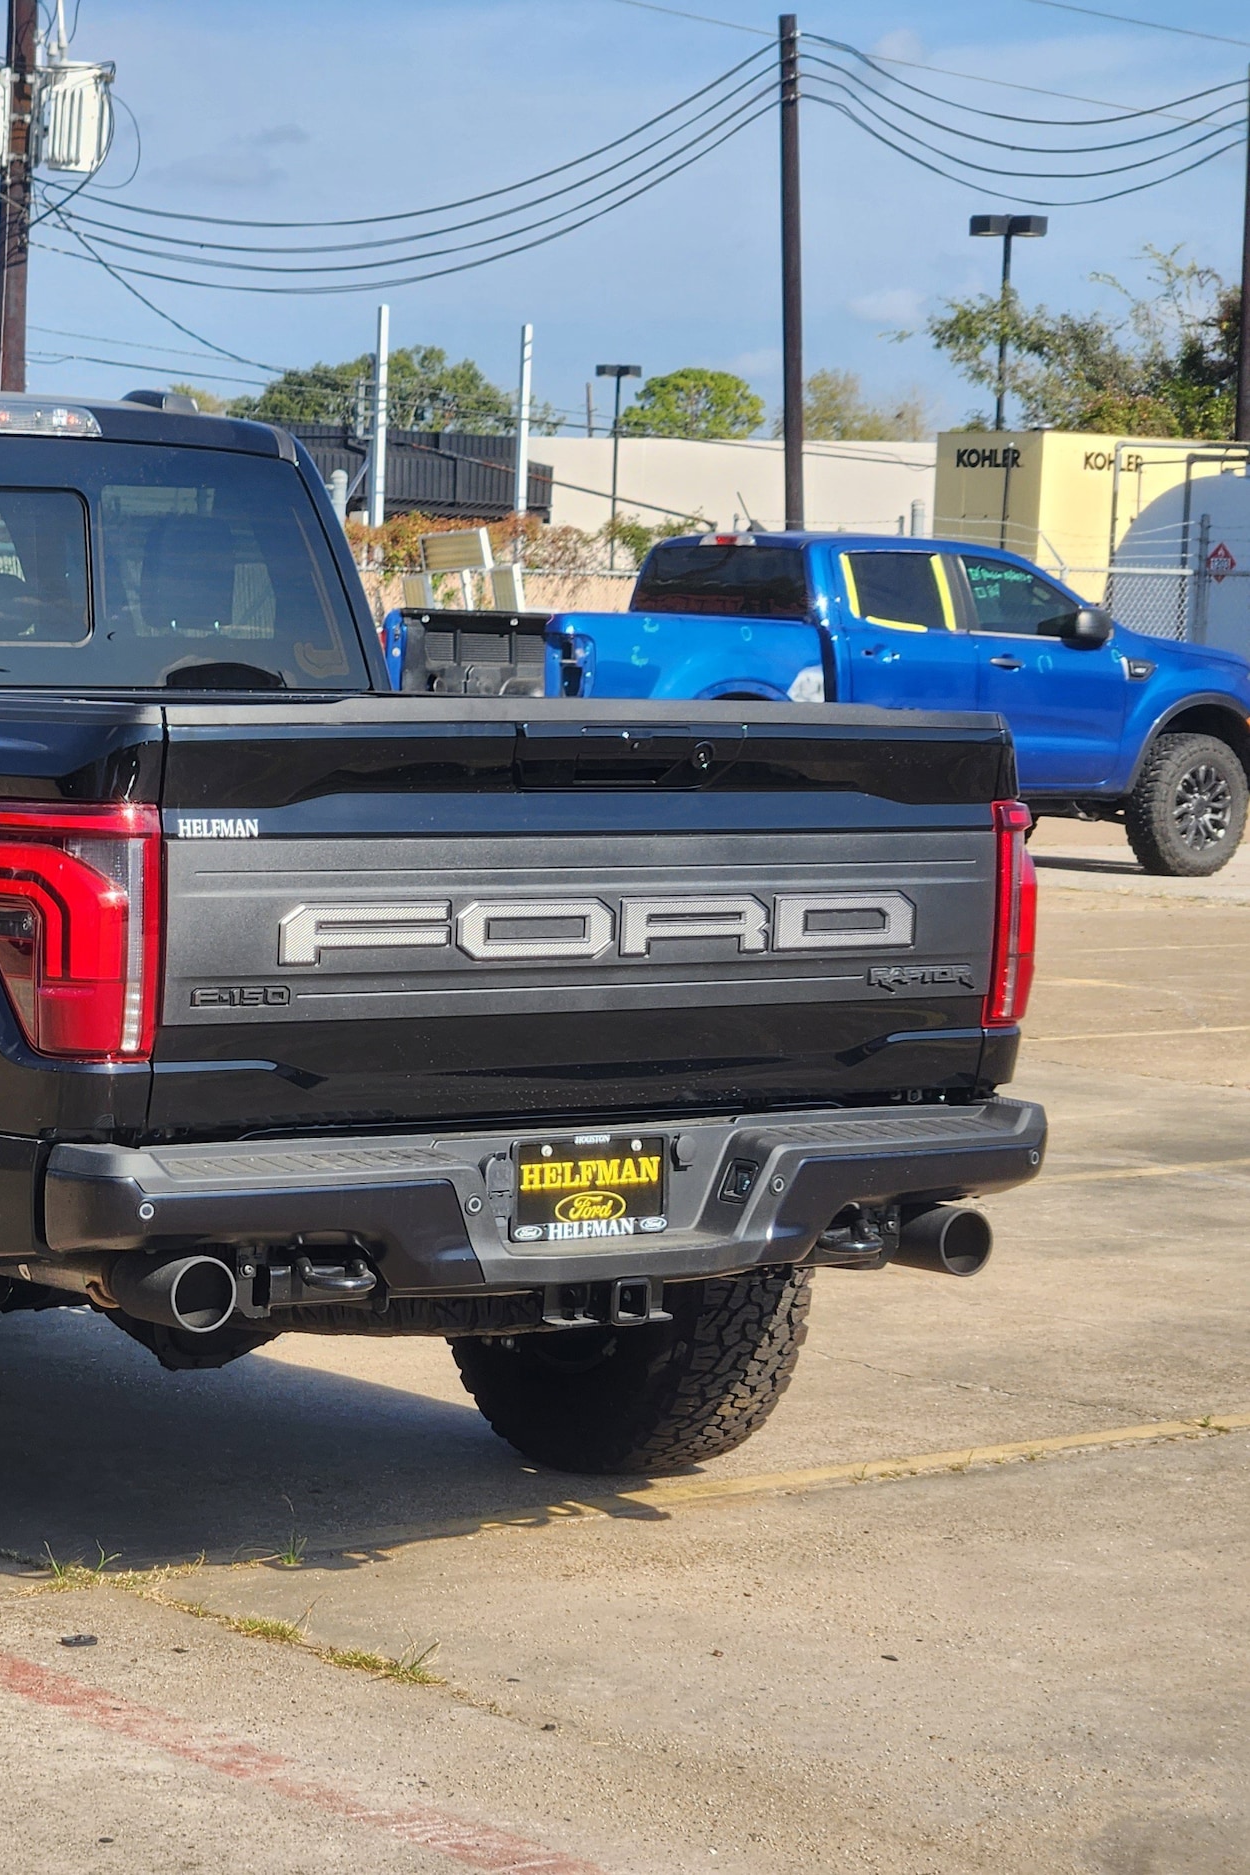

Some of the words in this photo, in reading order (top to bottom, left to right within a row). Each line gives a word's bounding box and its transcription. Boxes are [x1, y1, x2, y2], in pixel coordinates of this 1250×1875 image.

[956, 448, 1020, 468] KOHLER
[177, 818, 259, 838] HELFMAN
[278, 890, 916, 966] FORD
[867, 963, 975, 994] RAPTOR
[190, 986, 291, 1007] F-150
[574, 1134, 610, 1145] HOUSTON
[520, 1156, 661, 1191] HELFMAN
[568, 1196, 612, 1219] Ford
[547, 1217, 636, 1240] HELFMAN
